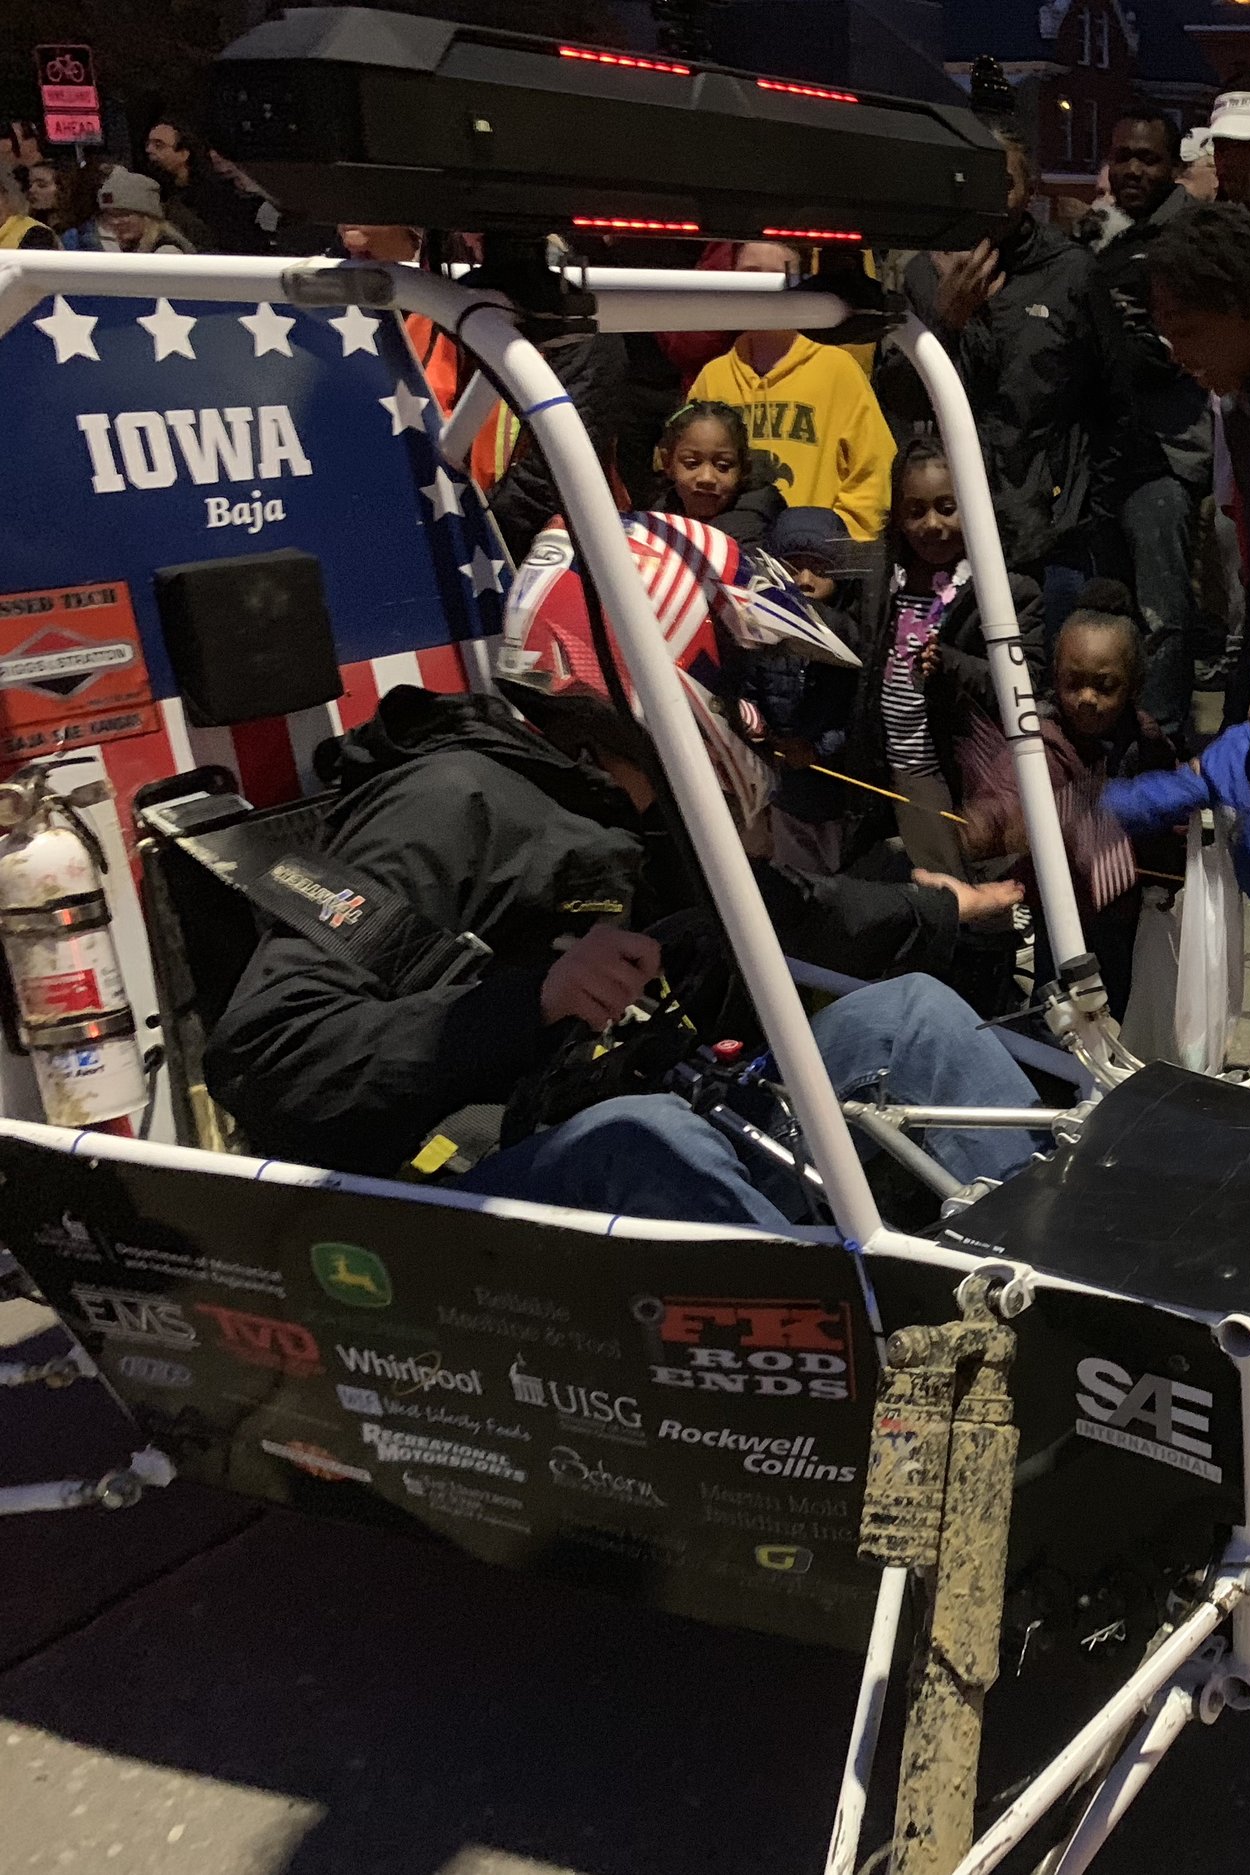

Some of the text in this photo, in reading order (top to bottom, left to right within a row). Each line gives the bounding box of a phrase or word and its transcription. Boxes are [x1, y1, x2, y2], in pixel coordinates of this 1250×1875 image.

[54, 120, 95, 136] AHEAD
[76, 405, 313, 494] IOWA
[204, 490, 287, 534] Baja
[336, 1344, 483, 1396] Whirlpool
[648, 1364, 849, 1400] ENDS
[686, 1346, 847, 1375] ROD
[548, 1380, 642, 1428] UISG
[1075, 1356, 1213, 1460] SAE
[658, 1418, 816, 1457] Rockwell
[1076, 1420, 1213, 1478] INTERNATIONAL
[743, 1453, 857, 1482] Collins
